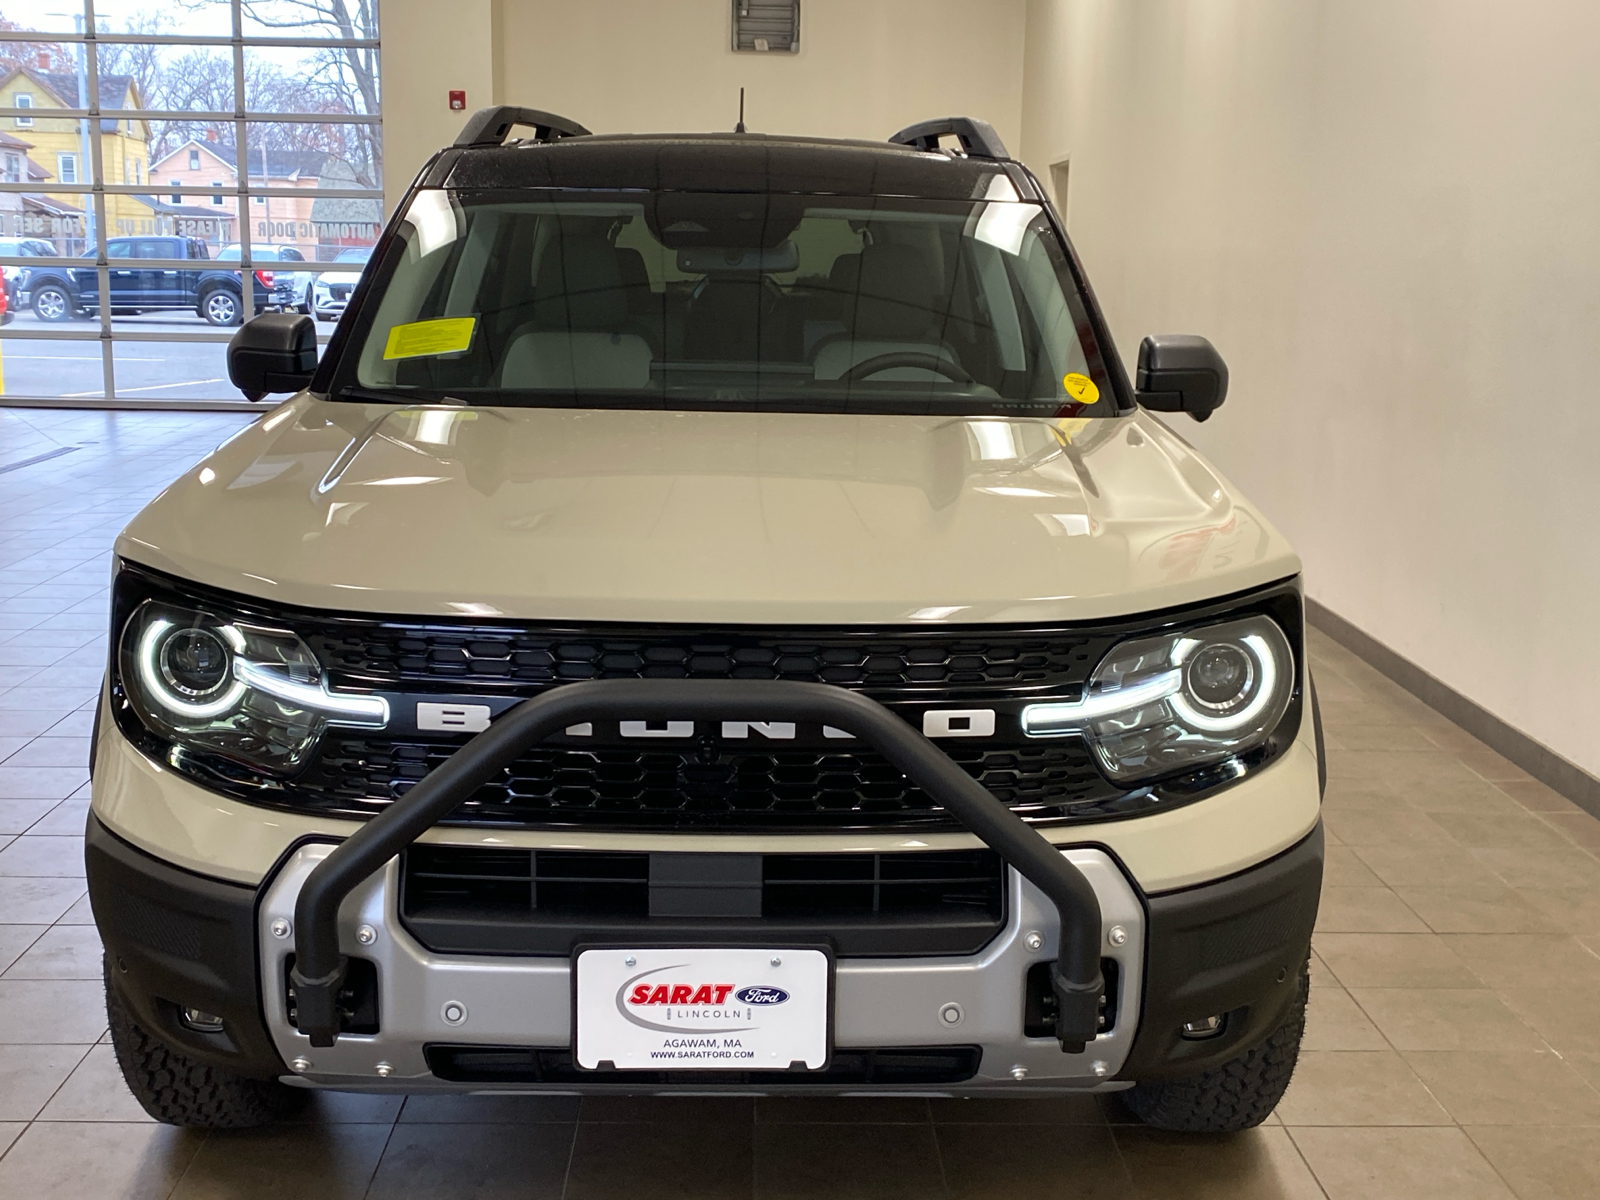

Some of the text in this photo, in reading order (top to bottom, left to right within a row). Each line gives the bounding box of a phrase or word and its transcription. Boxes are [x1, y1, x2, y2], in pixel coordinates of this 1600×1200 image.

[628, 983, 780, 1006] SARAT Ford
[677, 1010, 741, 1018] LINCOLN
[663, 1039, 742, 1049] AGAWAM, MA
[650, 1051, 755, 1059] WWW.SARATFORD.COM
